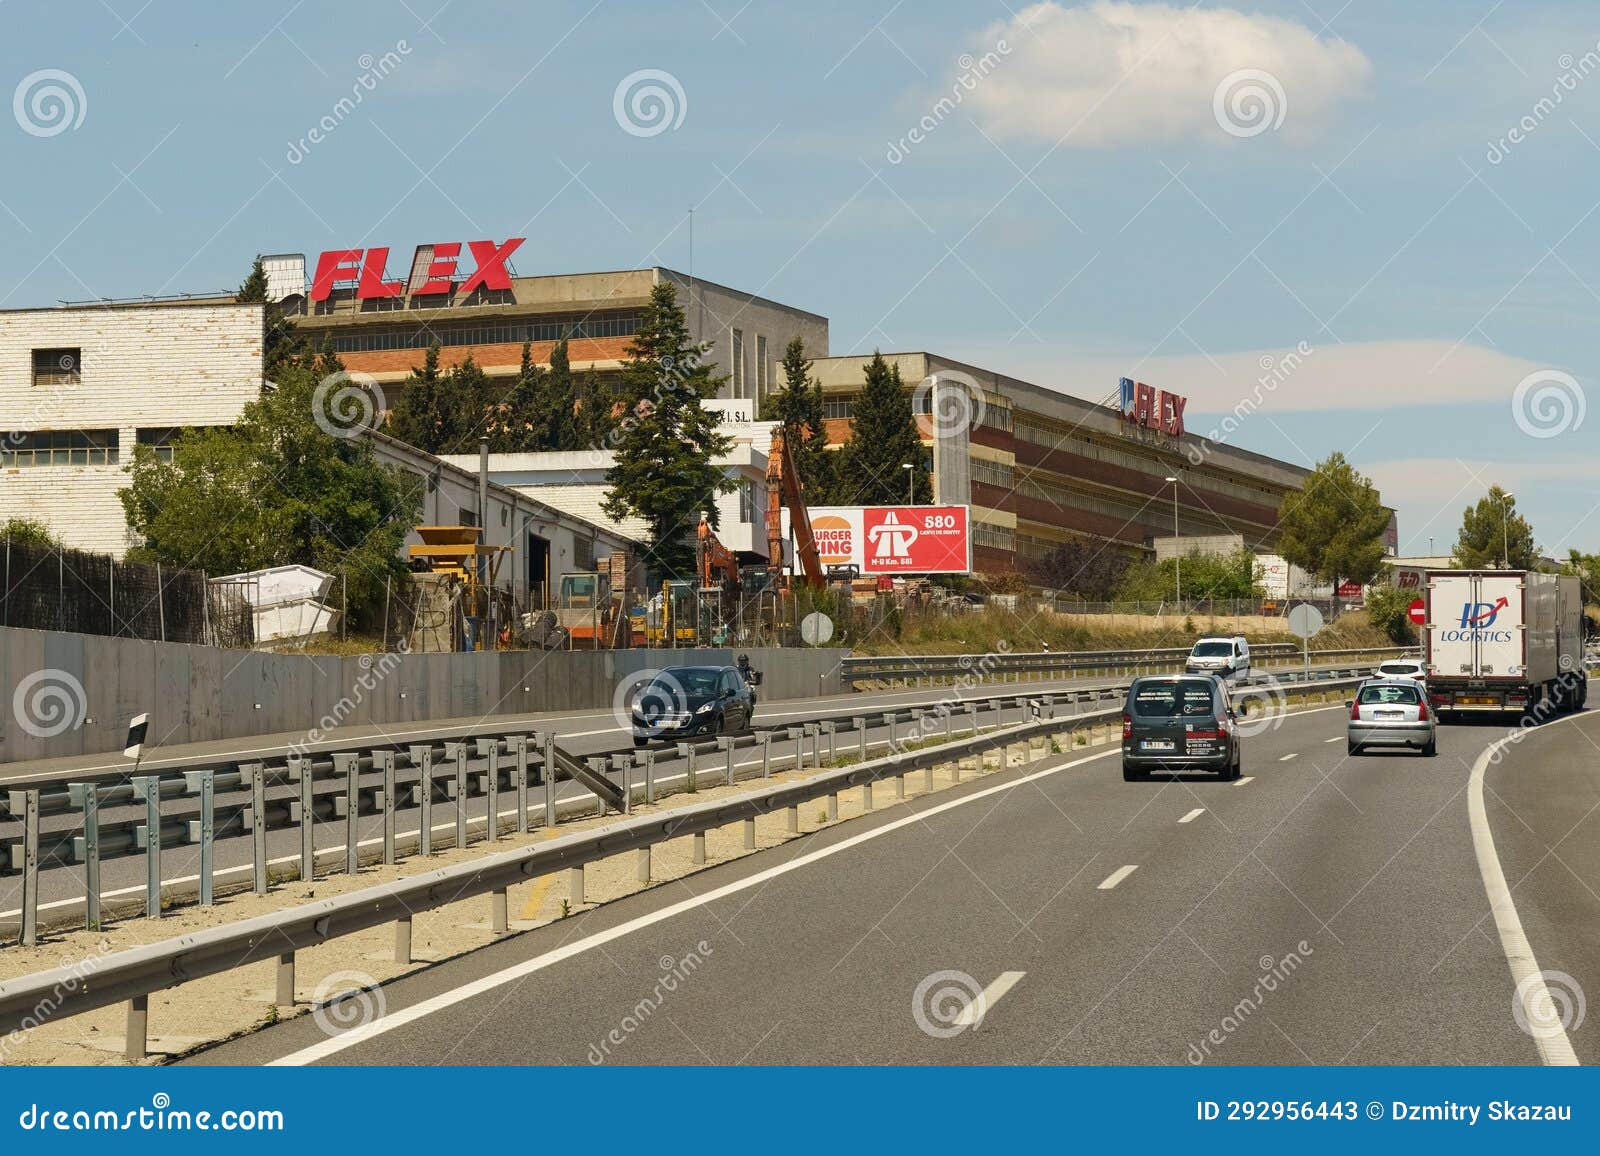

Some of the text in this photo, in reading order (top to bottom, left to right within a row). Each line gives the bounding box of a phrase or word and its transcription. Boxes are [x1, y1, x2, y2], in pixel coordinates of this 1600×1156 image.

[311, 238, 527, 301] FLEX
[1135, 382, 1188, 435] FLEX
[924, 515, 956, 528] 580
[815, 530, 852, 540] URGER
[1459, 602, 1499, 629] ID
[1440, 630, 1512, 643] LOGISTICS
